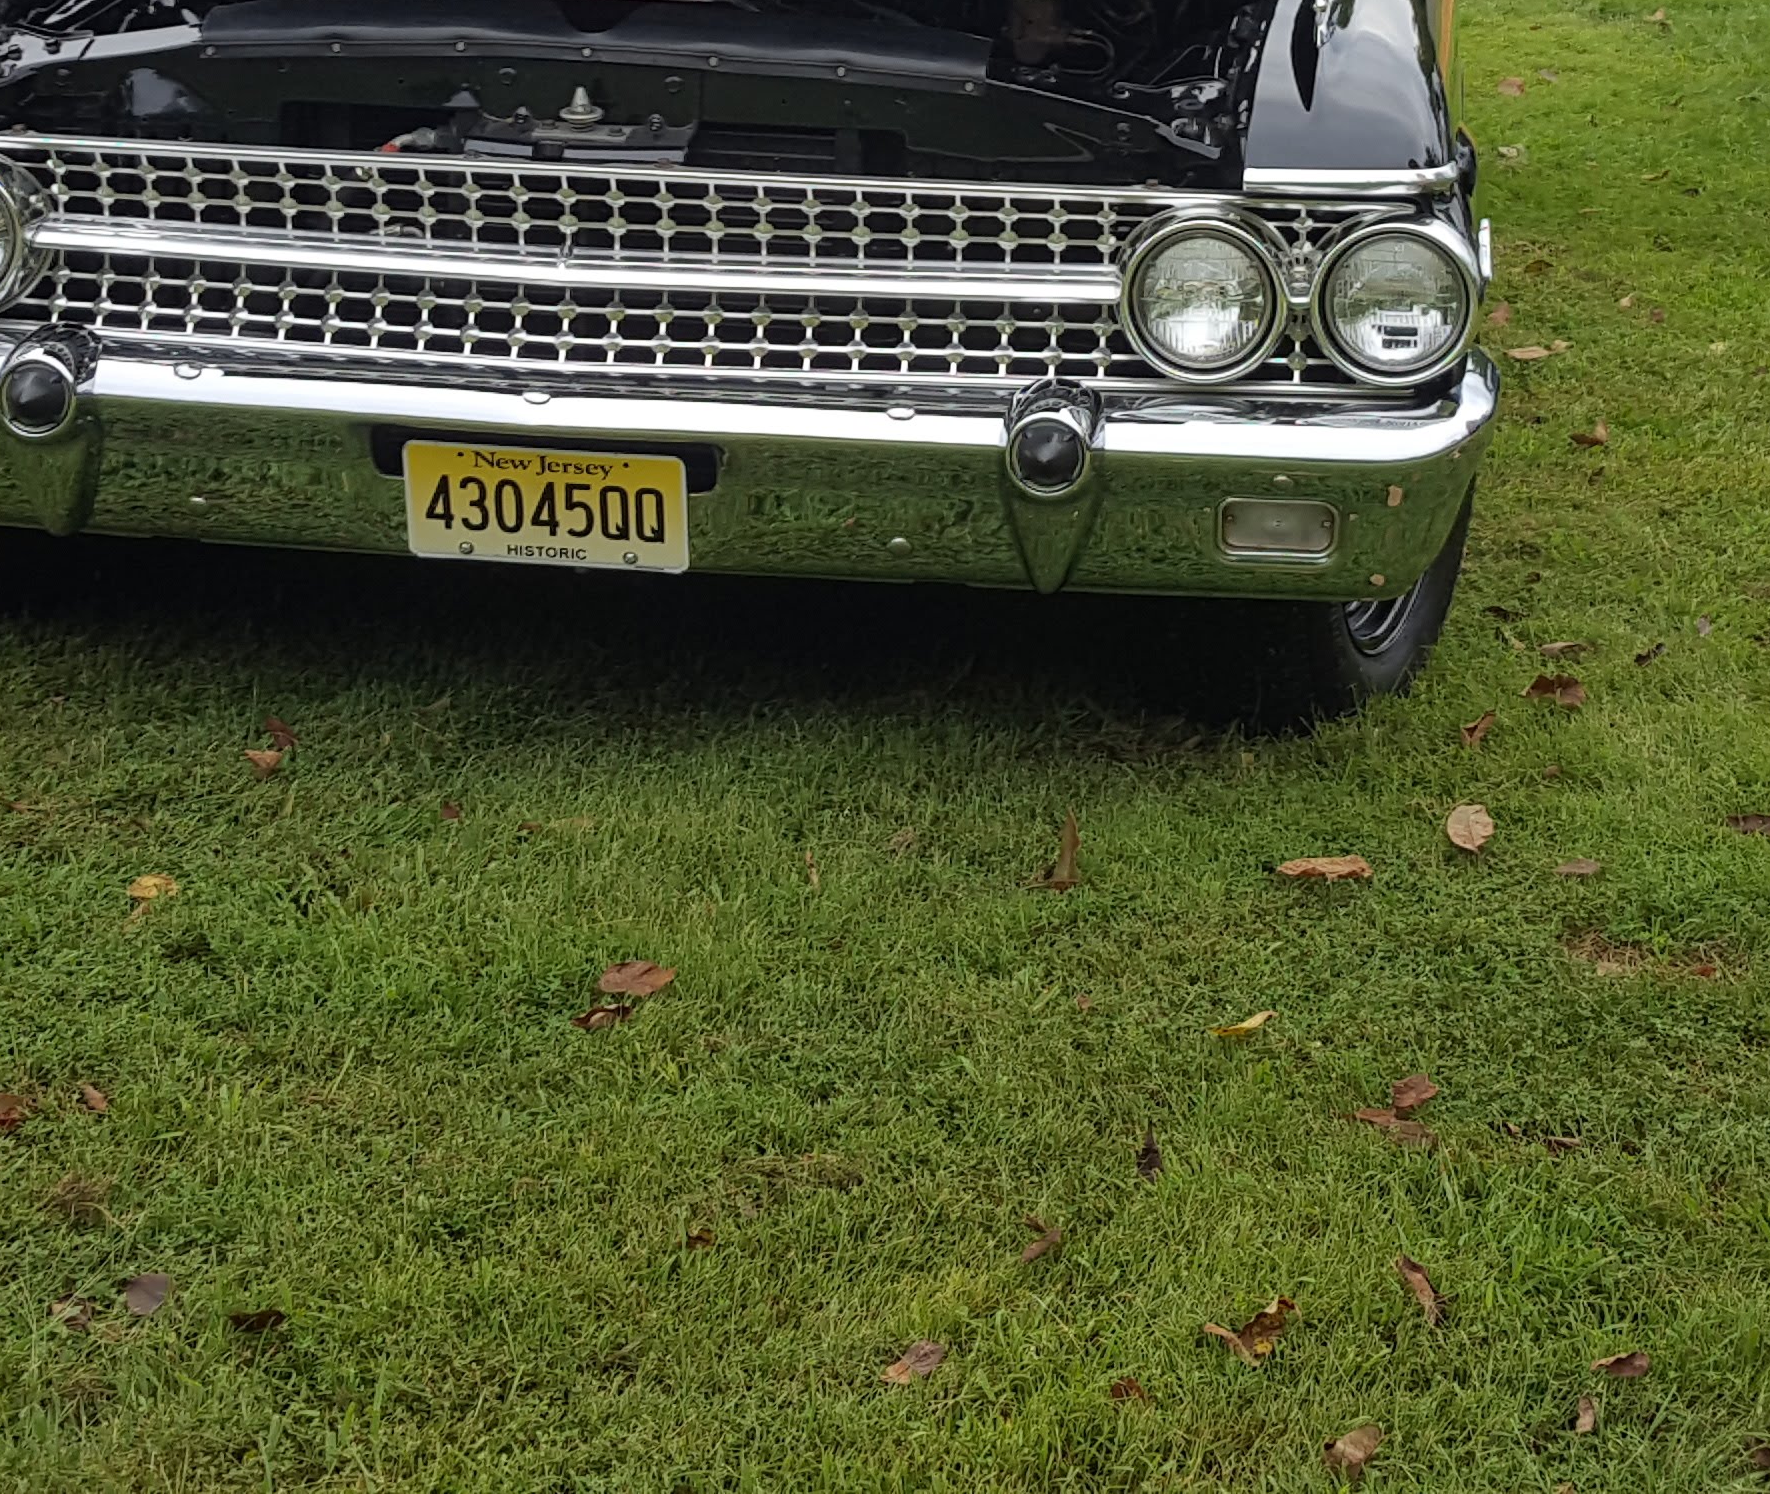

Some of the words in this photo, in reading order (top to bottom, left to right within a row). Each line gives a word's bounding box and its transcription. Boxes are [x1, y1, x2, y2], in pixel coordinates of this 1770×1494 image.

[471, 450, 532, 471] New
[535, 454, 614, 480] Jersey
[505, 543, 588, 561] HISTORIC
